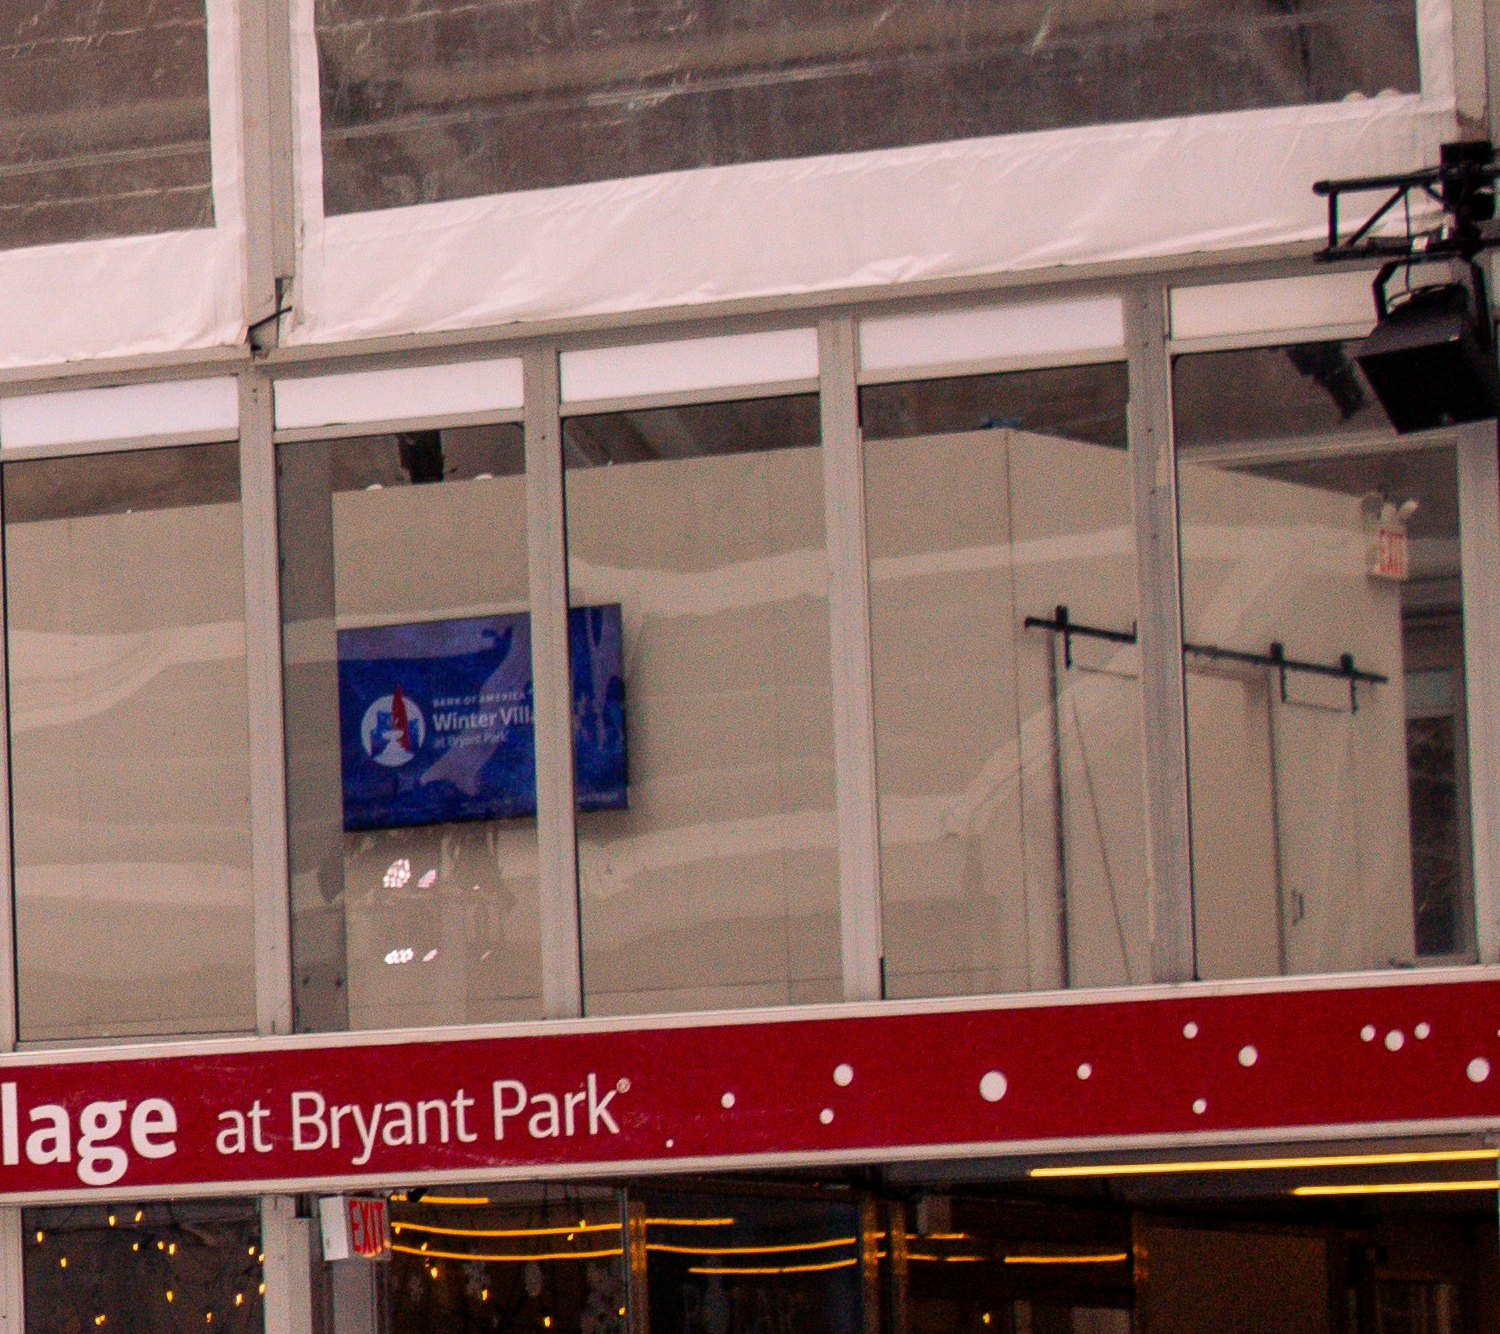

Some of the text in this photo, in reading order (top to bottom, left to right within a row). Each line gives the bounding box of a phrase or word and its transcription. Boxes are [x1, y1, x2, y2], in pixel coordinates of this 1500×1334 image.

[433, 703, 534, 732] Winter Vill
[214, 1099, 274, 1156] at
[290, 1088, 478, 1166] Bryant
[349, 1197, 385, 1255] EXIT
